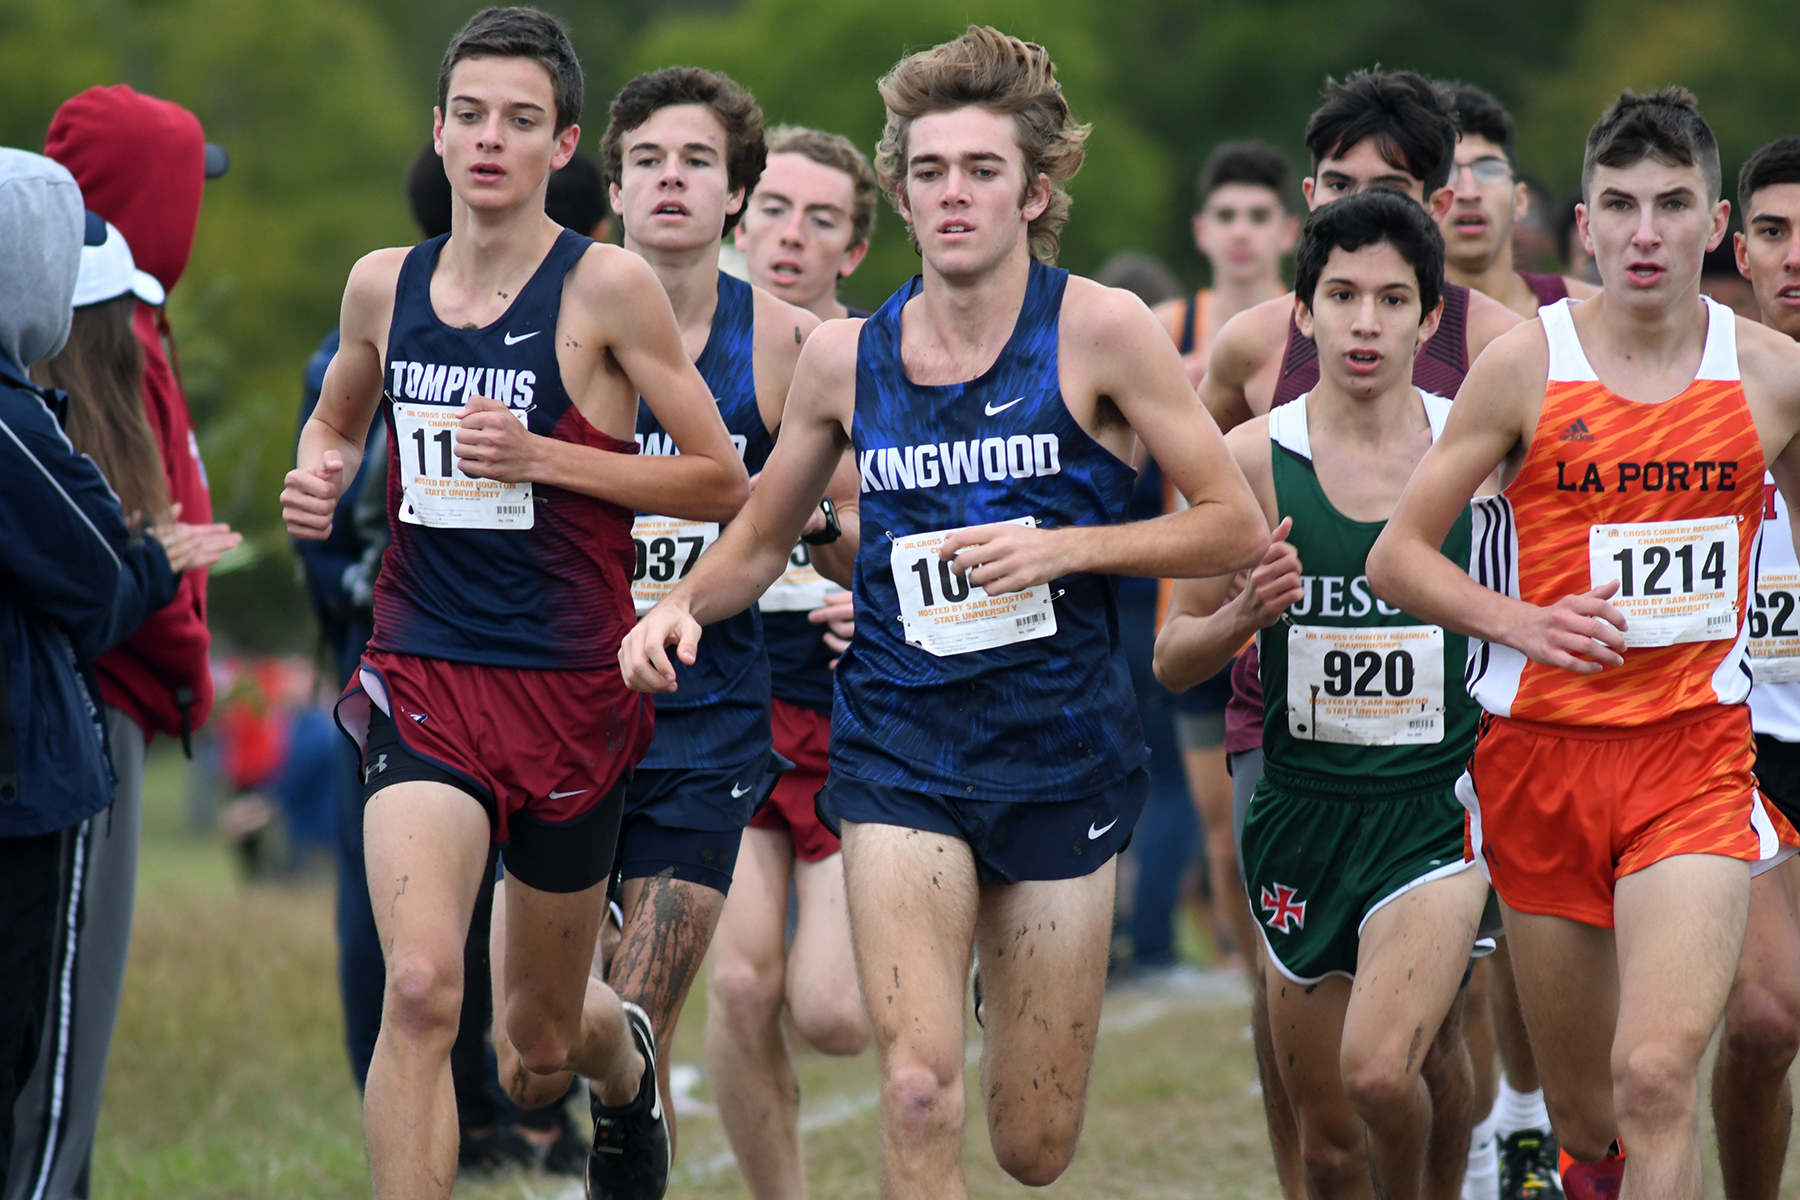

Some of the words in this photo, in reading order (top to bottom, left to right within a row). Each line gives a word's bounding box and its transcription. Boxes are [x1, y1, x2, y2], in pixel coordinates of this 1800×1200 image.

[391, 361, 536, 408] TOMPKINS
[860, 433, 1061, 493] KINGWOOD
[414, 477, 438, 487] HOSTED
[439, 479, 452, 487] BY
[454, 480, 474, 488] SAM
[476, 481, 517, 490] HOUSTON
[1557, 461, 1605, 492] LA
[1618, 461, 1738, 493] PORTE
[424, 488, 447, 496] STATE
[448, 489, 501, 498] UNIVERSITY
[632, 529, 680, 537] MPIONSHIPS
[1623, 529, 1652, 537] CROSS
[1653, 527, 1690, 536] COUNTRY
[1692, 523, 1729, 533] REGIONAL
[917, 538, 942, 547] CROSS
[1638, 534, 1704, 545] CHAMPIONSHIPS
[634, 535, 705, 582] 037
[1613, 541, 1726, 597] 1214
[918, 606, 950, 617] HOSTED
[952, 604, 963, 612] BY
[967, 600, 987, 610] SAM
[989, 591, 1033, 605] HOUSTON
[1613, 598, 1649, 607] HOSTED
[1651, 597, 1663, 605] BY
[1666, 595, 1686, 604] SAM
[1689, 591, 1725, 603] HOUSTON
[934, 615, 960, 625] STATE
[962, 604, 1018, 620] UNIVERSITY
[1631, 608, 1658, 616] STATE
[1661, 603, 1710, 615] UNIVERSITY
[1349, 633, 1388, 641] COUNTRY
[1390, 632, 1431, 640] REGIONAL
[1765, 639, 1776, 647] BY
[1779, 638, 1800, 646] SAM
[1323, 650, 1414, 697] 920
[1385, 697, 1429, 706] HOUSTON
[1326, 707, 1353, 715] STATE
[1356, 707, 1411, 715] UNIVERSITY
